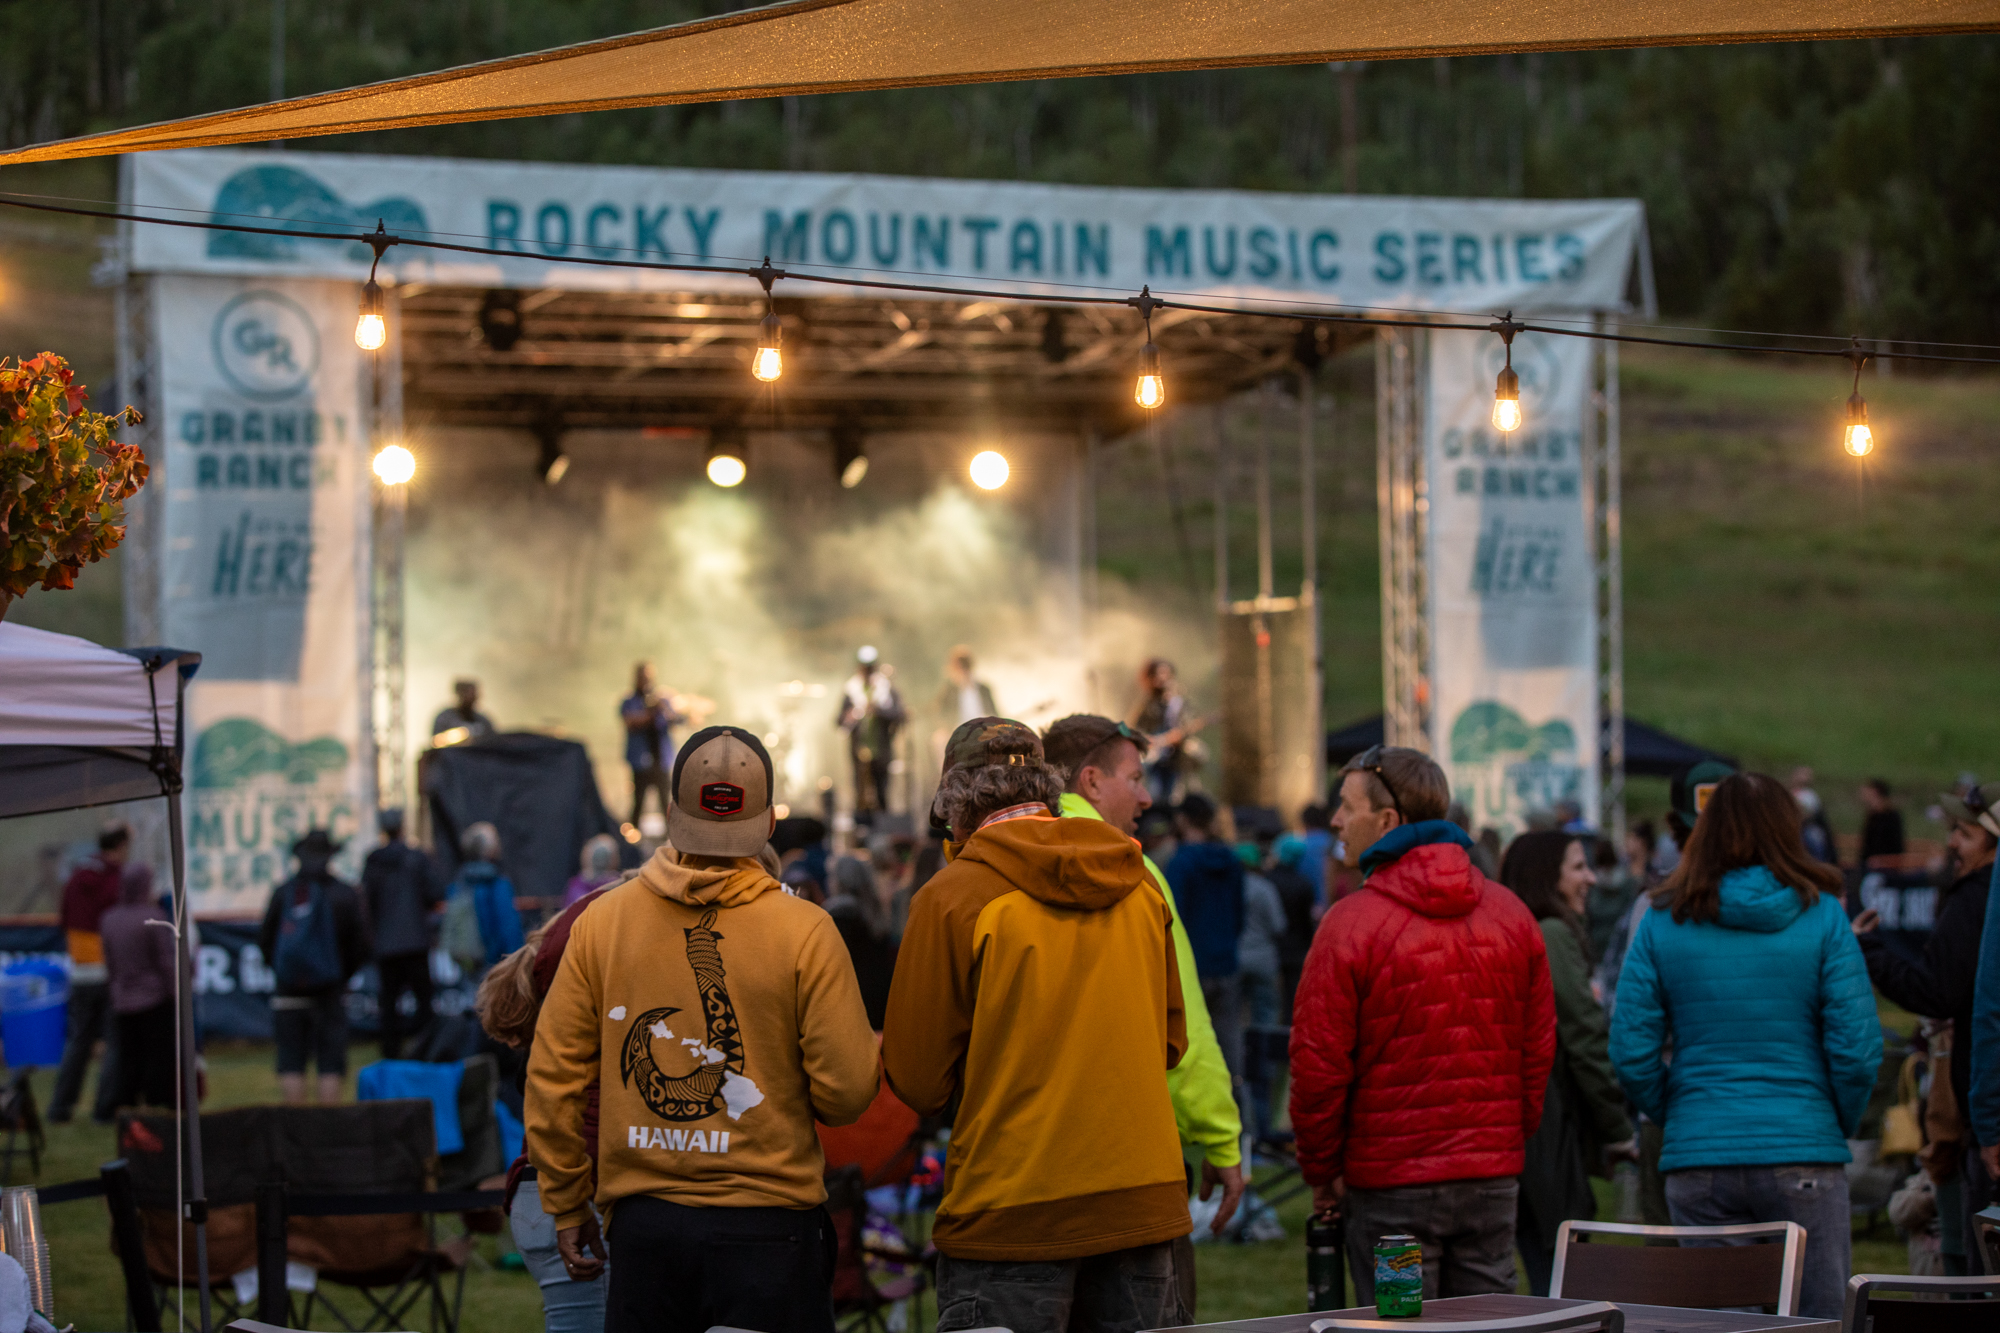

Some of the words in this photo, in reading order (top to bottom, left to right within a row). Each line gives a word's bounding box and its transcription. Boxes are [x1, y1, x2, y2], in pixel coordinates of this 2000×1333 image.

[486, 200, 721, 261] ROCKY
[761, 207, 1111, 277] MOUNTAIN
[1144, 224, 1341, 281] MUSIC
[1373, 230, 1585, 284] SERIES
[189, 805, 353, 848] MUSIC
[627, 1125, 731, 1154] HAWAII
